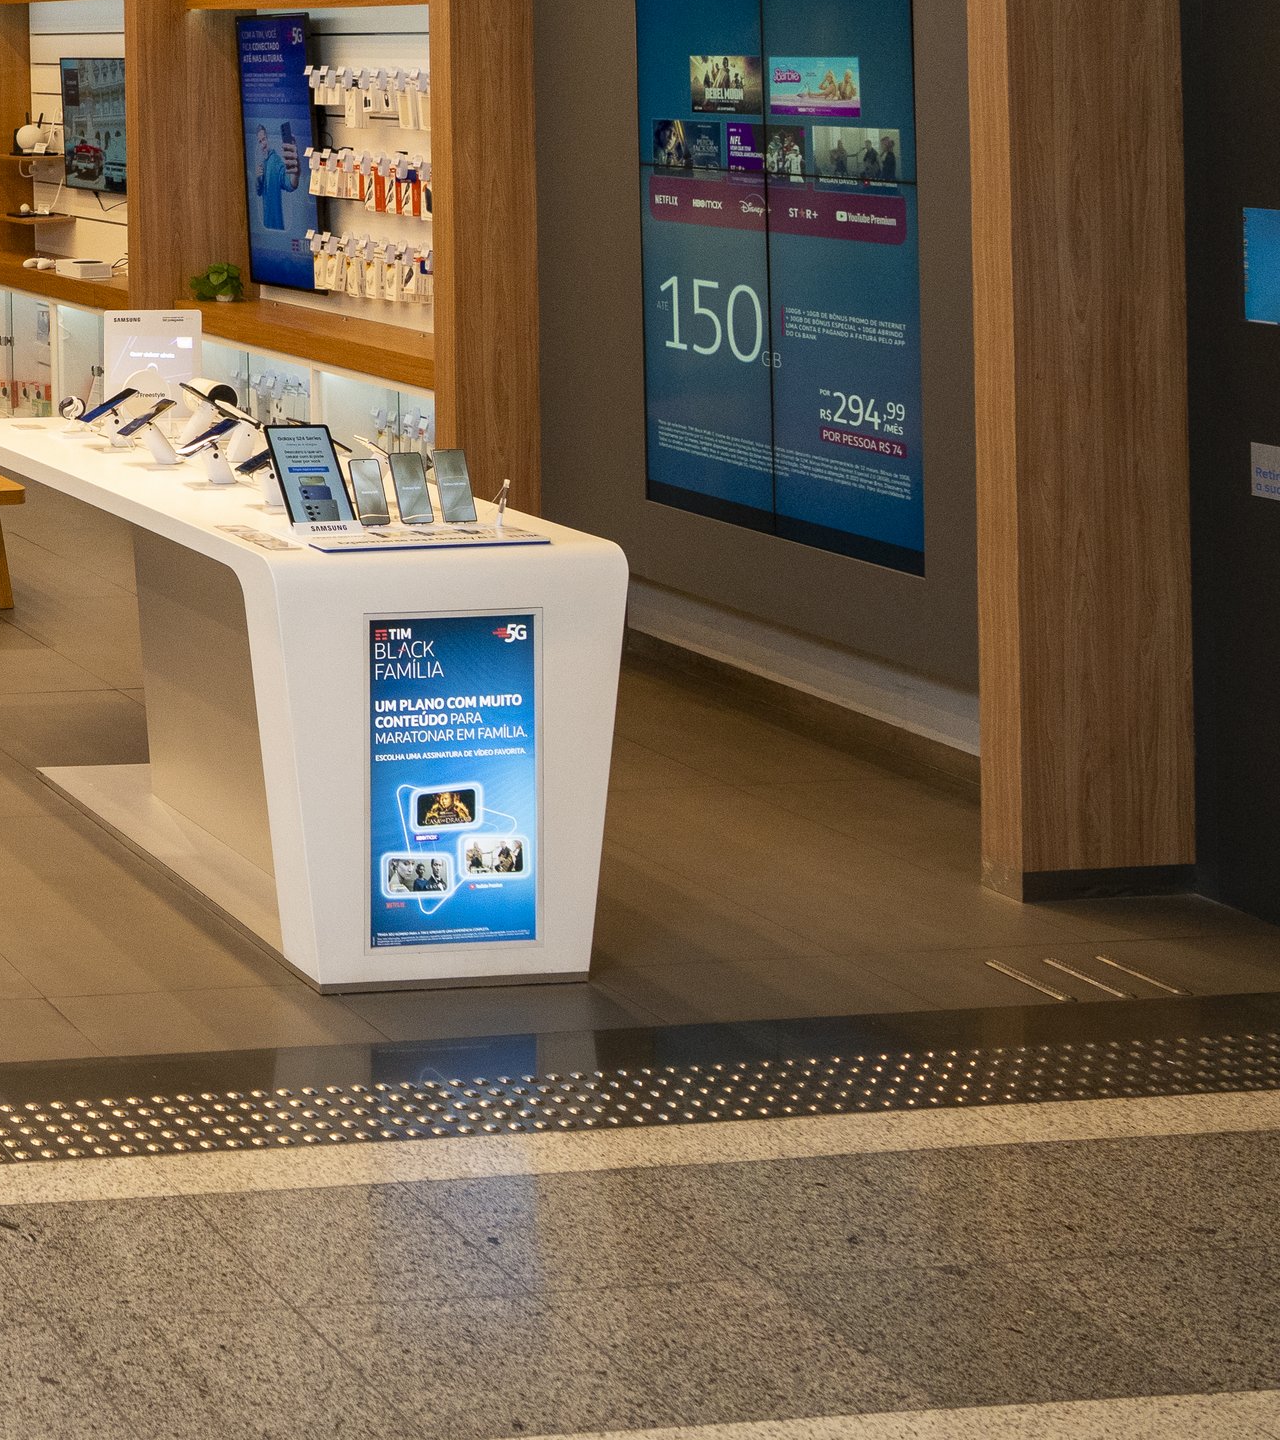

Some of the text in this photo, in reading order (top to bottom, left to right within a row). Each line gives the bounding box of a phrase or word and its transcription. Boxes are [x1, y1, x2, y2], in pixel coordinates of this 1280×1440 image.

[292, 27, 303, 46] 5G
[252, 42, 280, 51] CONECTADO
[243, 53, 252, 63] ATÉ
[262, 54, 284, 62] ALTURAS.
[654, 194, 678, 207] NETFLIX
[659, 275, 763, 363] 150
[762, 350, 782, 368] GB
[140, 392, 166, 400] Freestyle
[819, 388, 831, 397] POR
[820, 407, 832, 422] R$
[883, 421, 904, 436] /MÊS
[823, 430, 902, 455] POR PESSOA R$ 74
[389, 628, 412, 640] TIM
[505, 624, 527, 643] 5G
[375, 640, 435, 659] BLACK
[375, 659, 444, 680] FAMÍLIA
[376, 694, 522, 712] UM PLANO COM MUITO
[375, 712, 482, 728] CONTEÚDO PARA
[376, 725, 527, 743] MARATONAR EM FAMÍLIA.
